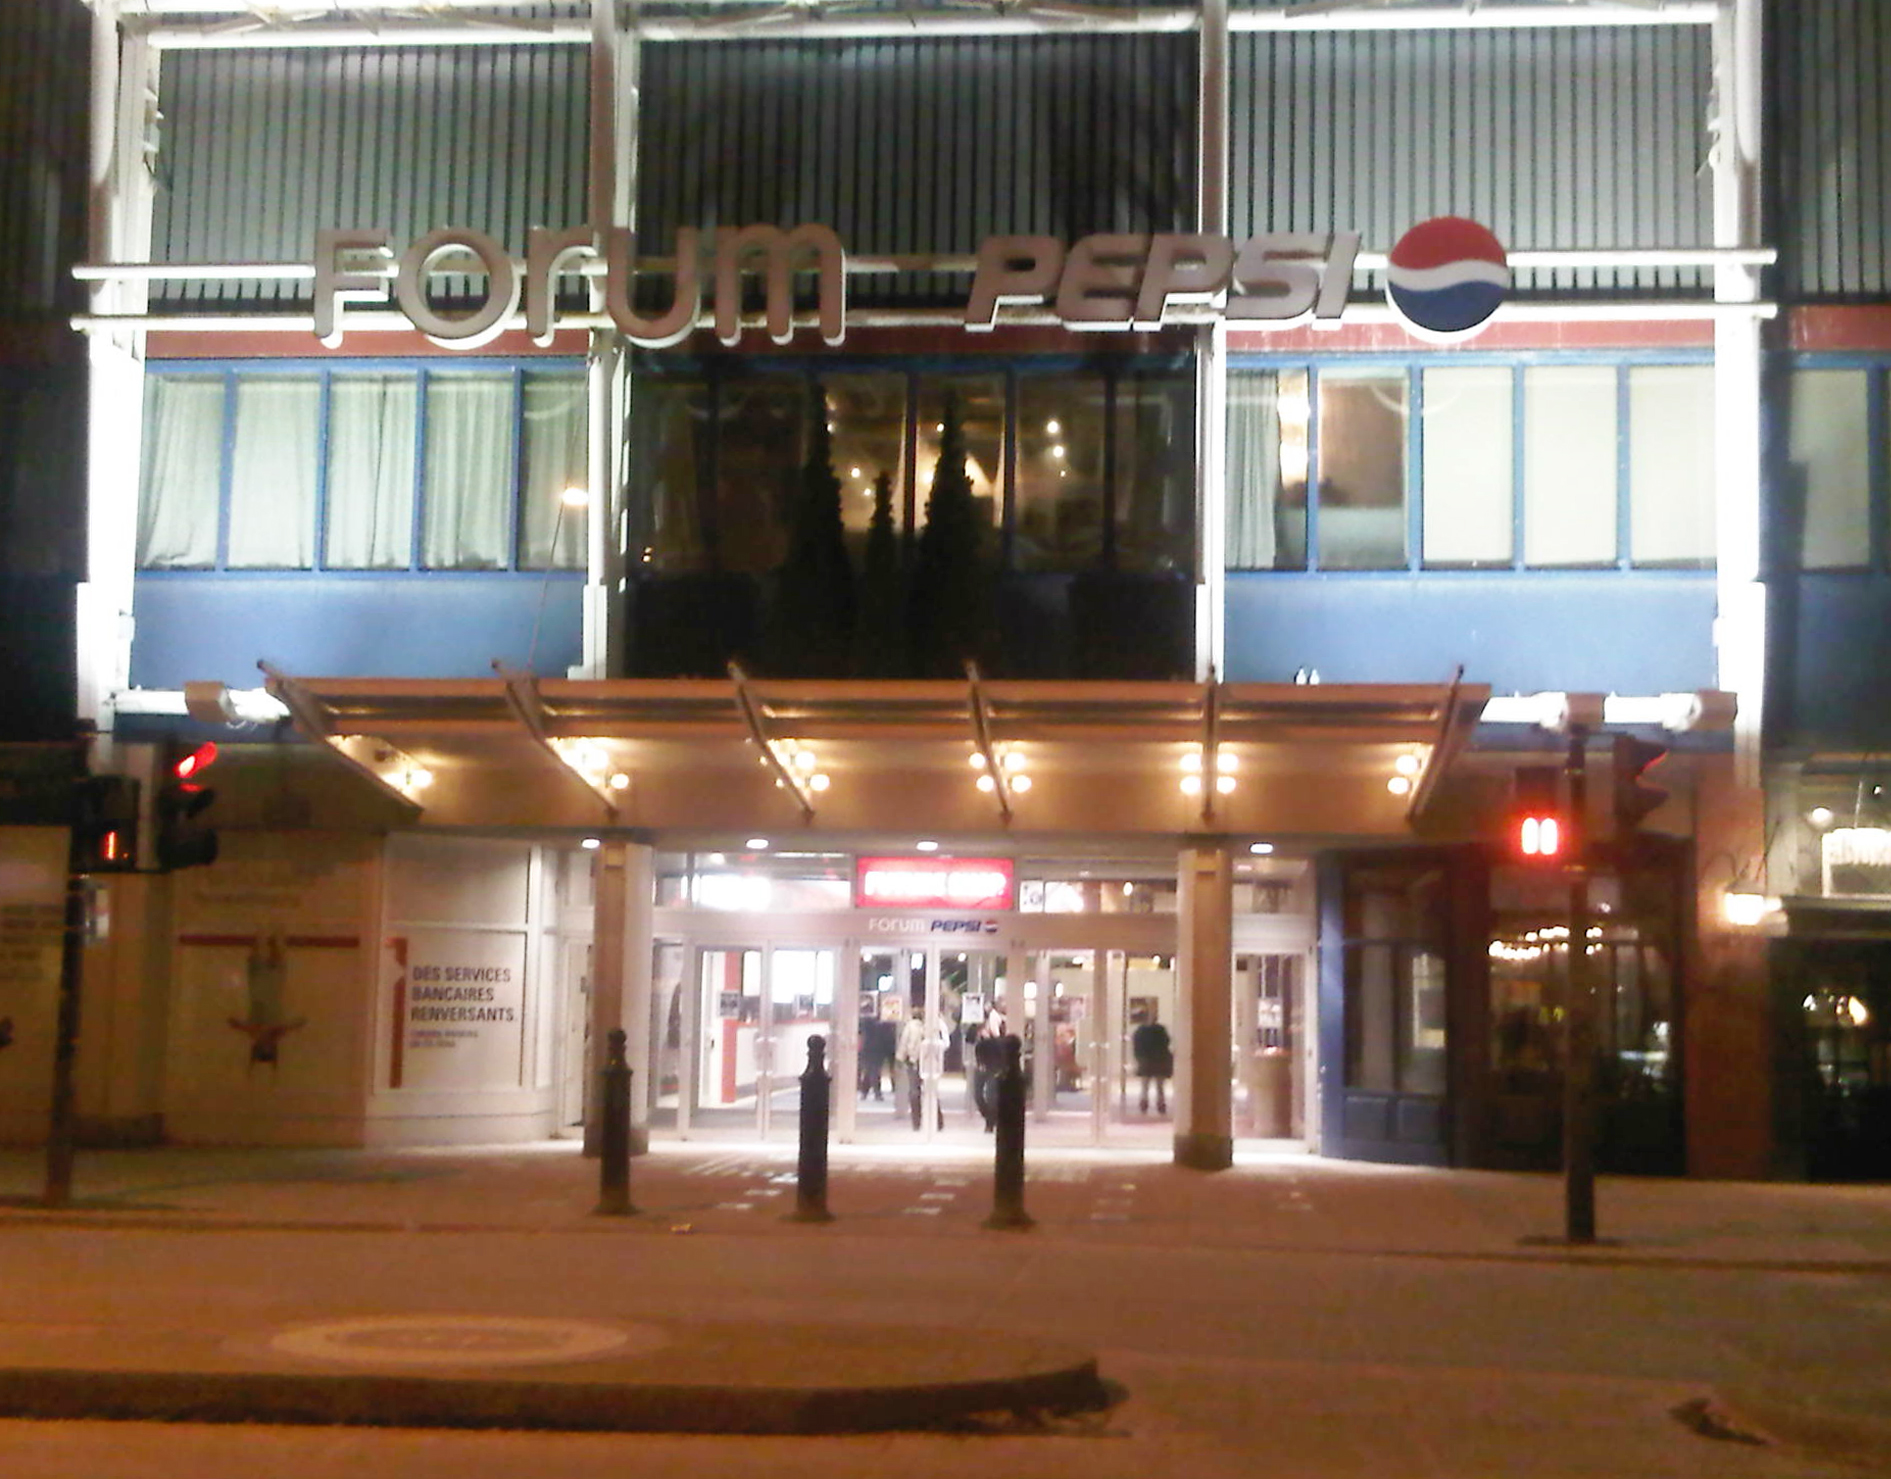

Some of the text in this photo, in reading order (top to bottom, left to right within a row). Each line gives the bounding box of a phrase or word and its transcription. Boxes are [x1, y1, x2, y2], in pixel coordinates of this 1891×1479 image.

[963, 229, 1363, 332] PEPSI
[930, 919, 982, 932] PEPSI
[413, 967, 511, 981] DES SERVICES
[412, 987, 494, 1001] BANCAIRES
[411, 1007, 514, 1021] RENVERSANTS
